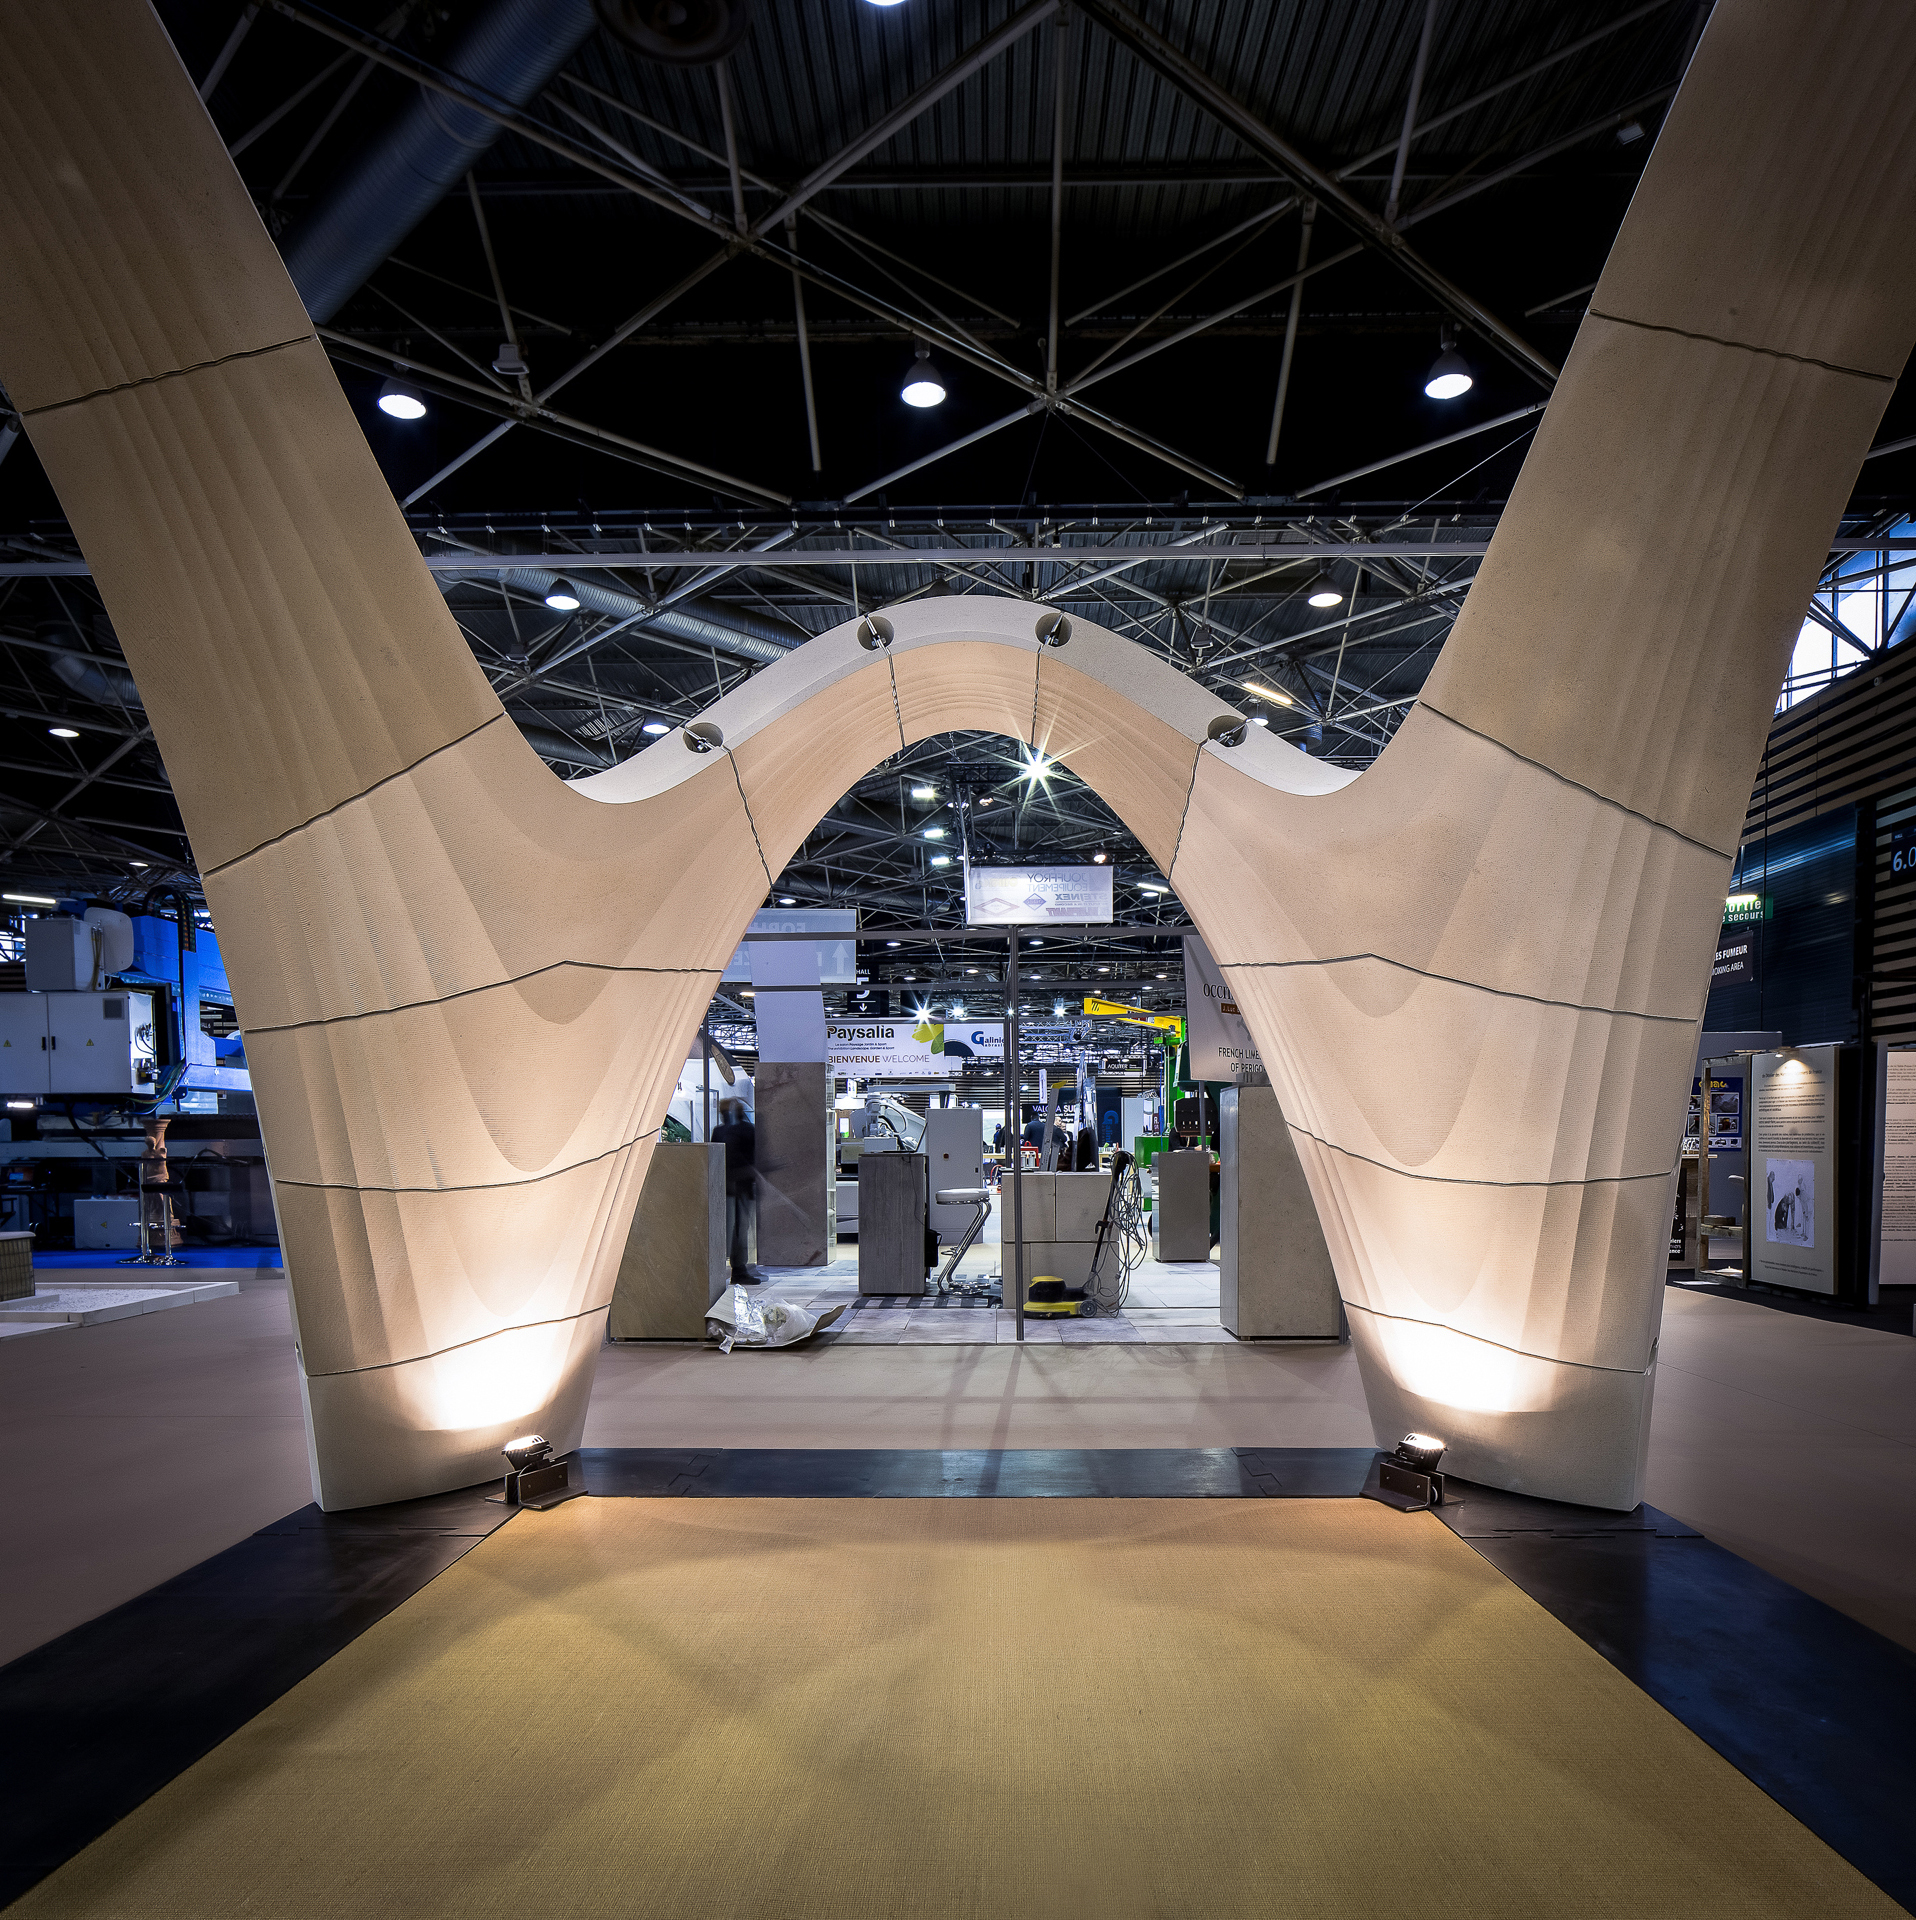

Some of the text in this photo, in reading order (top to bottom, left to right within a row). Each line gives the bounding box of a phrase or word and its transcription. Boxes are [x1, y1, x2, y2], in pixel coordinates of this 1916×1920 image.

[1731, 961, 1744, 971] AREA
[1203, 983, 1235, 1000] OCCIT
[827, 1025, 894, 1041] Paysalia
[1218, 1047, 1244, 1059] FRENCH
[882, 1055, 930, 1063] WELCOME
[1230, 1062, 1239, 1072] OF
